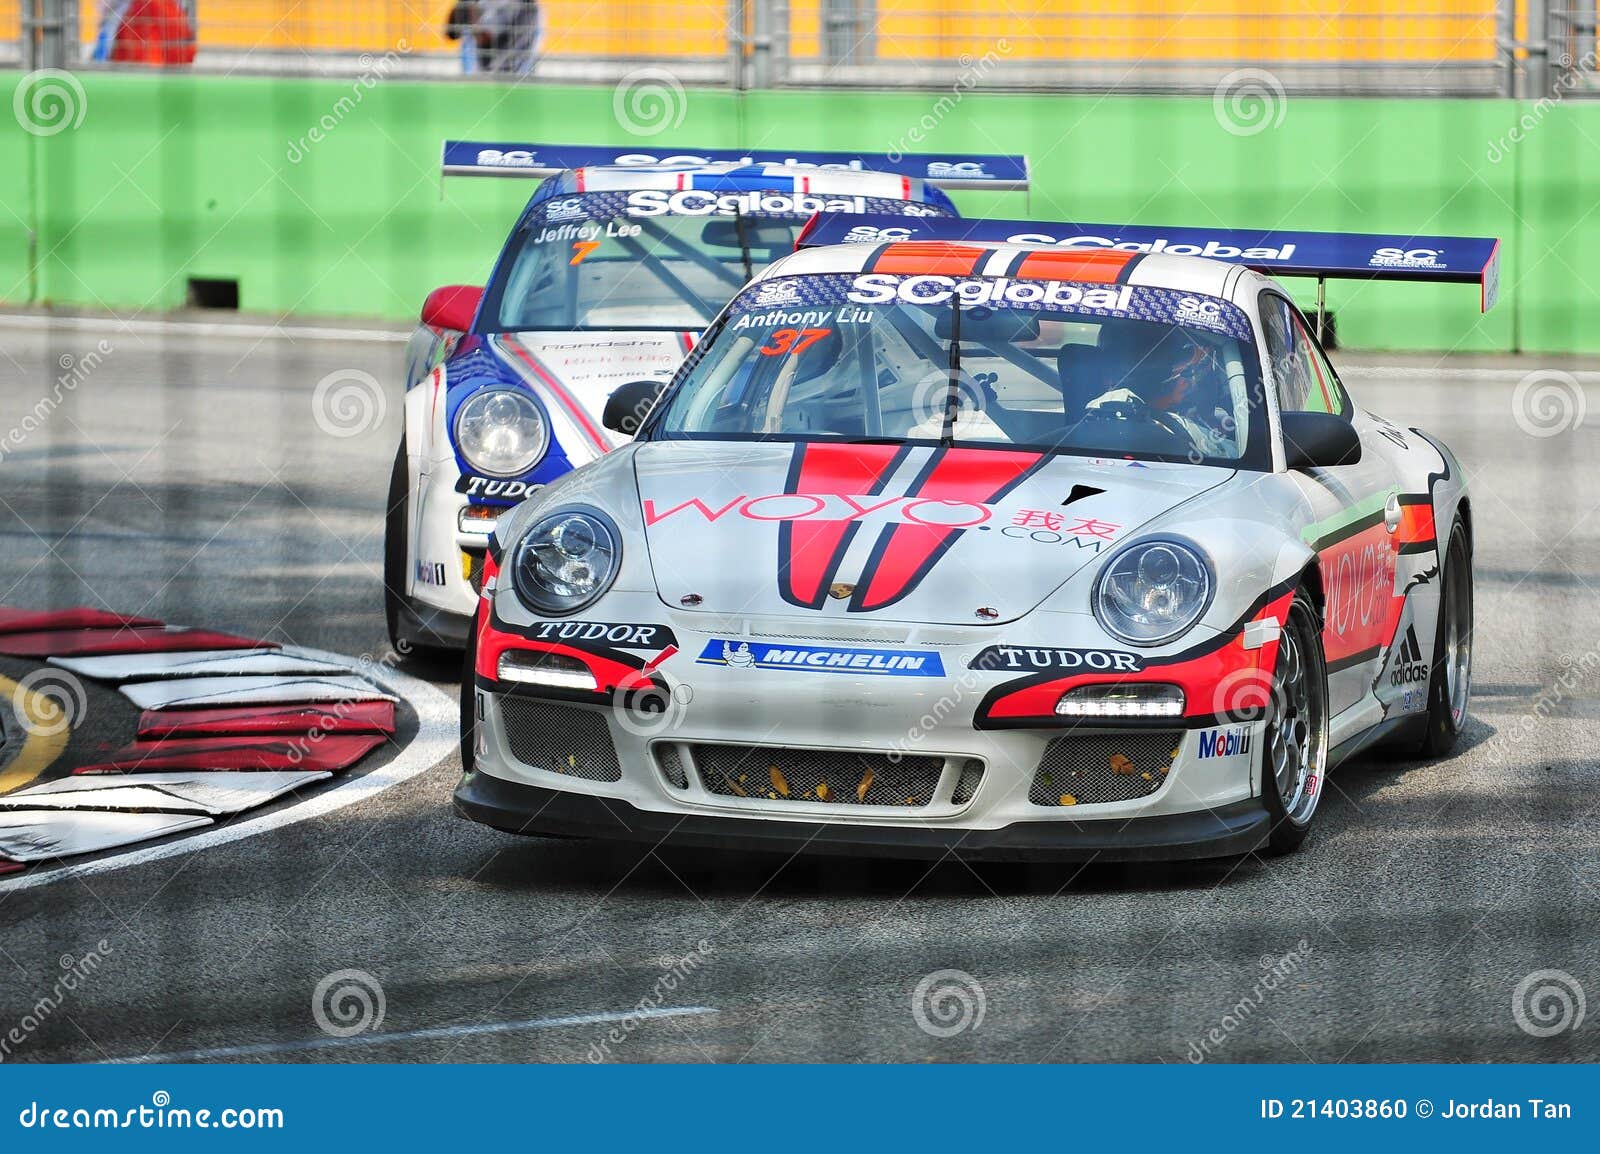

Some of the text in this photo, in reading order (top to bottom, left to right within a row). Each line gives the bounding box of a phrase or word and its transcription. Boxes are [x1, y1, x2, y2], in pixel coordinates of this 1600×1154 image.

[626, 190, 865, 216] SCglobal
[534, 221, 642, 244] Jeffrey Lee
[569, 241, 602, 267] 7
[1374, 247, 1438, 260] SC
[760, 281, 798, 295] SC
[847, 273, 1134, 311] SCglobal
[1179, 297, 1220, 315] SC
[732, 307, 874, 331] Anthony Liu
[760, 328, 832, 356] 37
[466, 476, 546, 498] TUDO
[643, 493, 993, 527] WOYO
[1012, 508, 1121, 541] 我友
[537, 622, 657, 645] TUDOR
[763, 649, 925, 671] MICHELIN
[1000, 648, 1141, 672] TUDOR
[1390, 663, 1429, 687] adidas
[1198, 728, 1241, 759] Mobil
